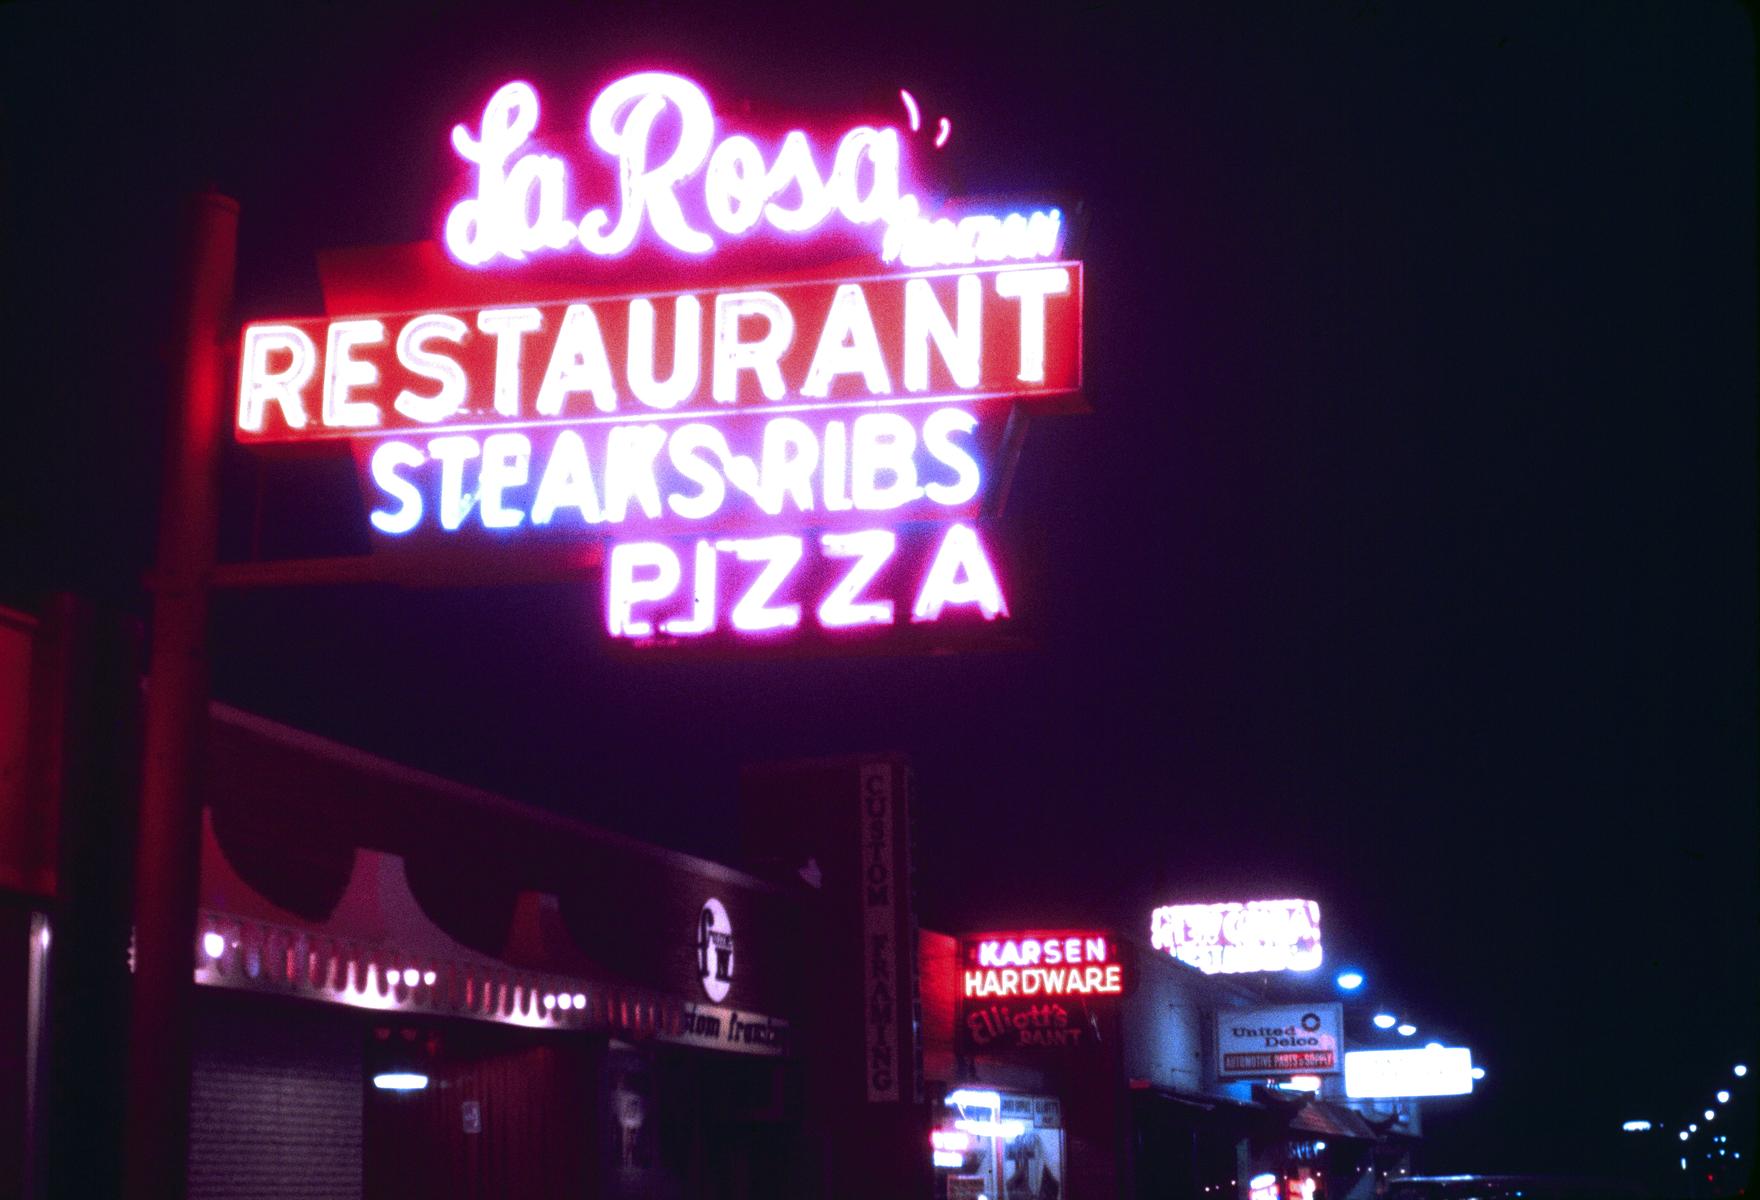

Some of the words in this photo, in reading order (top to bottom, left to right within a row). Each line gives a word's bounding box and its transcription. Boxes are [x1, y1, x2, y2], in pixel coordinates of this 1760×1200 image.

[446, 81, 577, 265] La
[237, 268, 1071, 432] RESTAURANT
[369, 423, 727, 534] STEAKS
[757, 407, 981, 516] RIBS
[606, 523, 1010, 639] PIZZA
[866, 775, 890, 906] CUSTOM
[964, 966, 1122, 997] HARDWARE
[979, 936, 1107, 966] KARSEN
[1232, 1025, 1297, 1038] United
[1265, 1036, 1319, 1048] Delco
